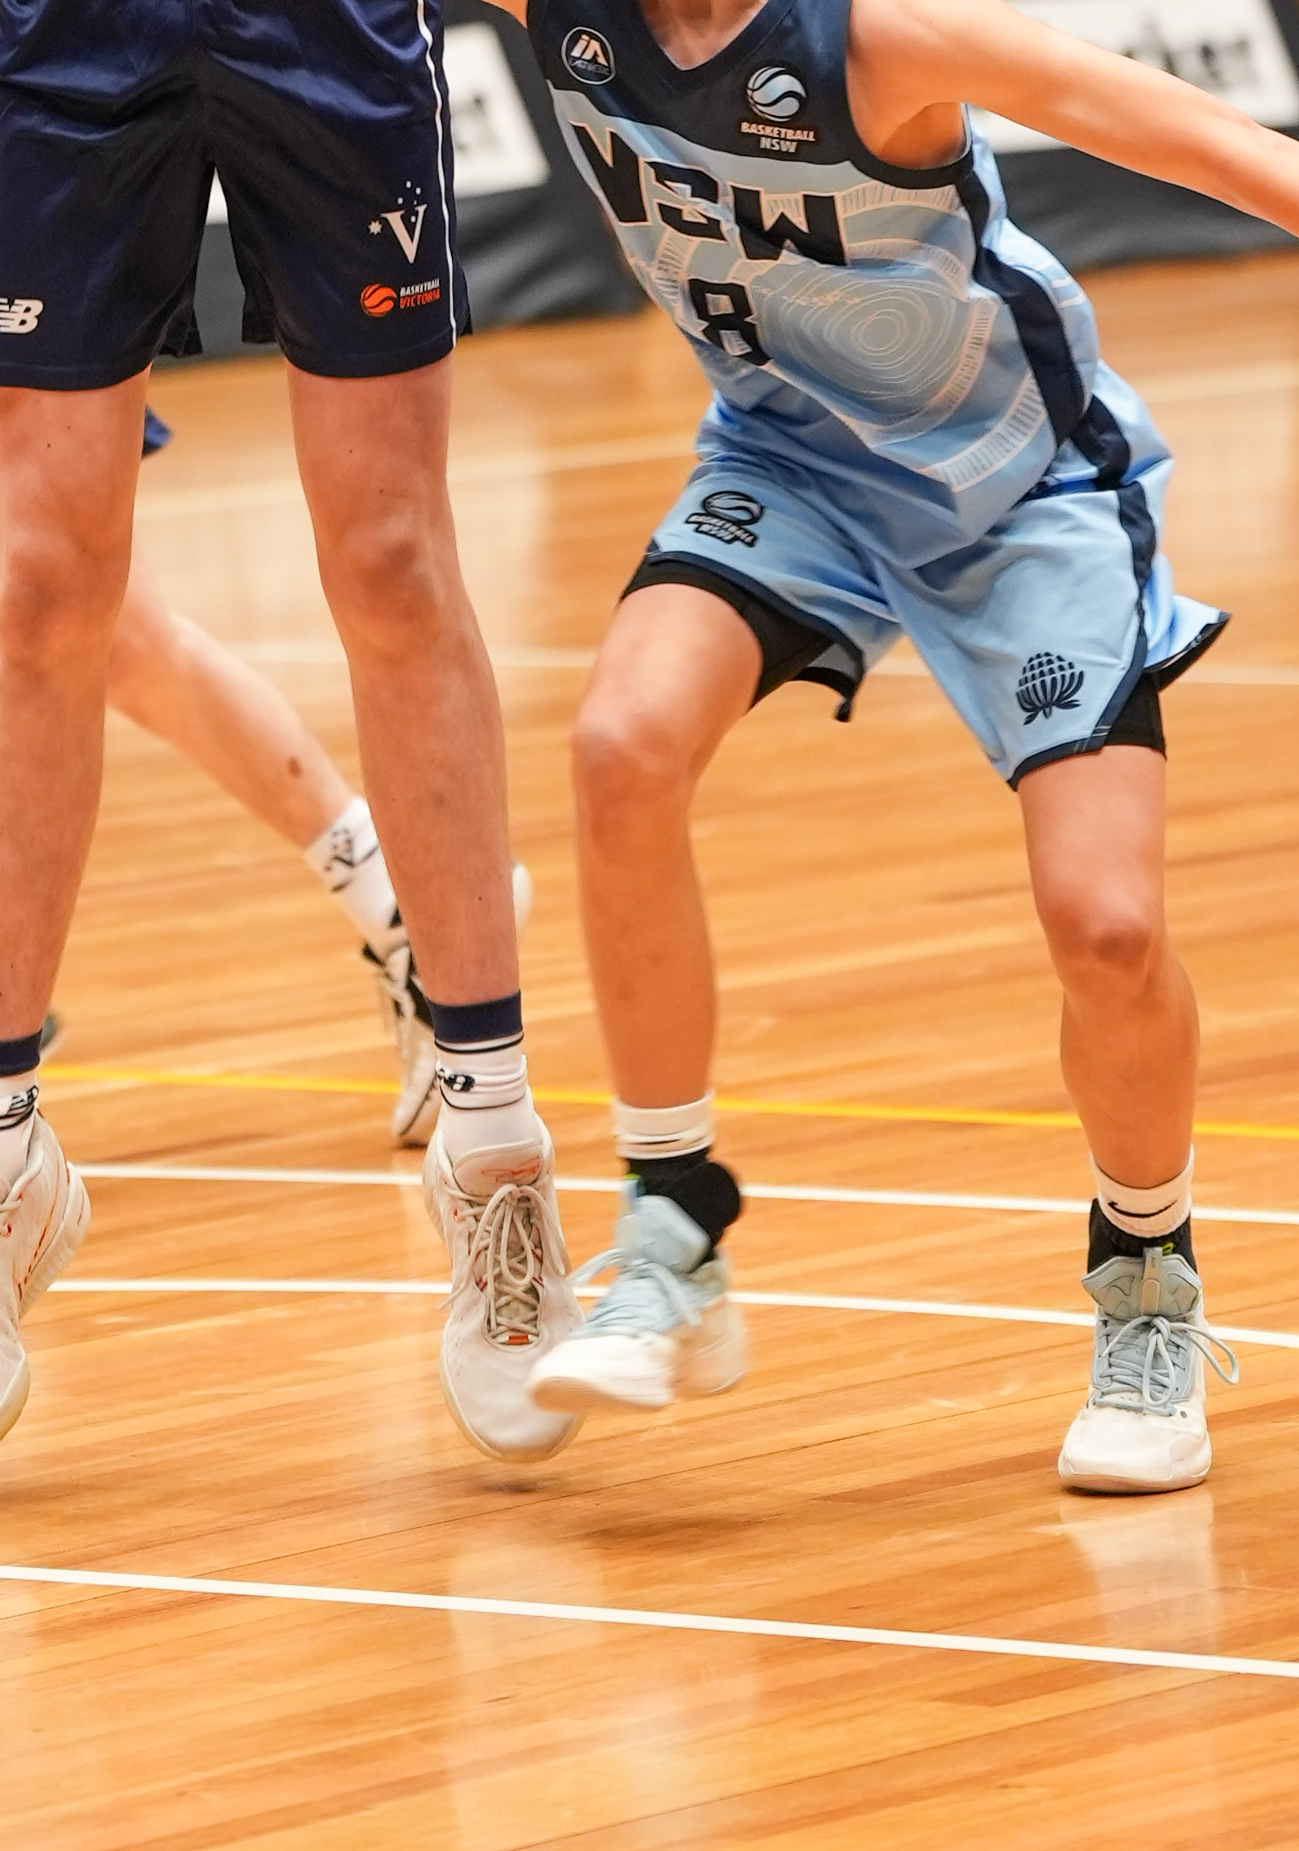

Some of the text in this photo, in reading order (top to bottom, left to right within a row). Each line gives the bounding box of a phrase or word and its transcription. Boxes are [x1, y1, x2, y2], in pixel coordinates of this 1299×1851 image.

[740, 121, 816, 142] BASKETBALL
[759, 136, 798, 154] NSW
[568, 121, 849, 268] NSW
[687, 277, 773, 368] 8
